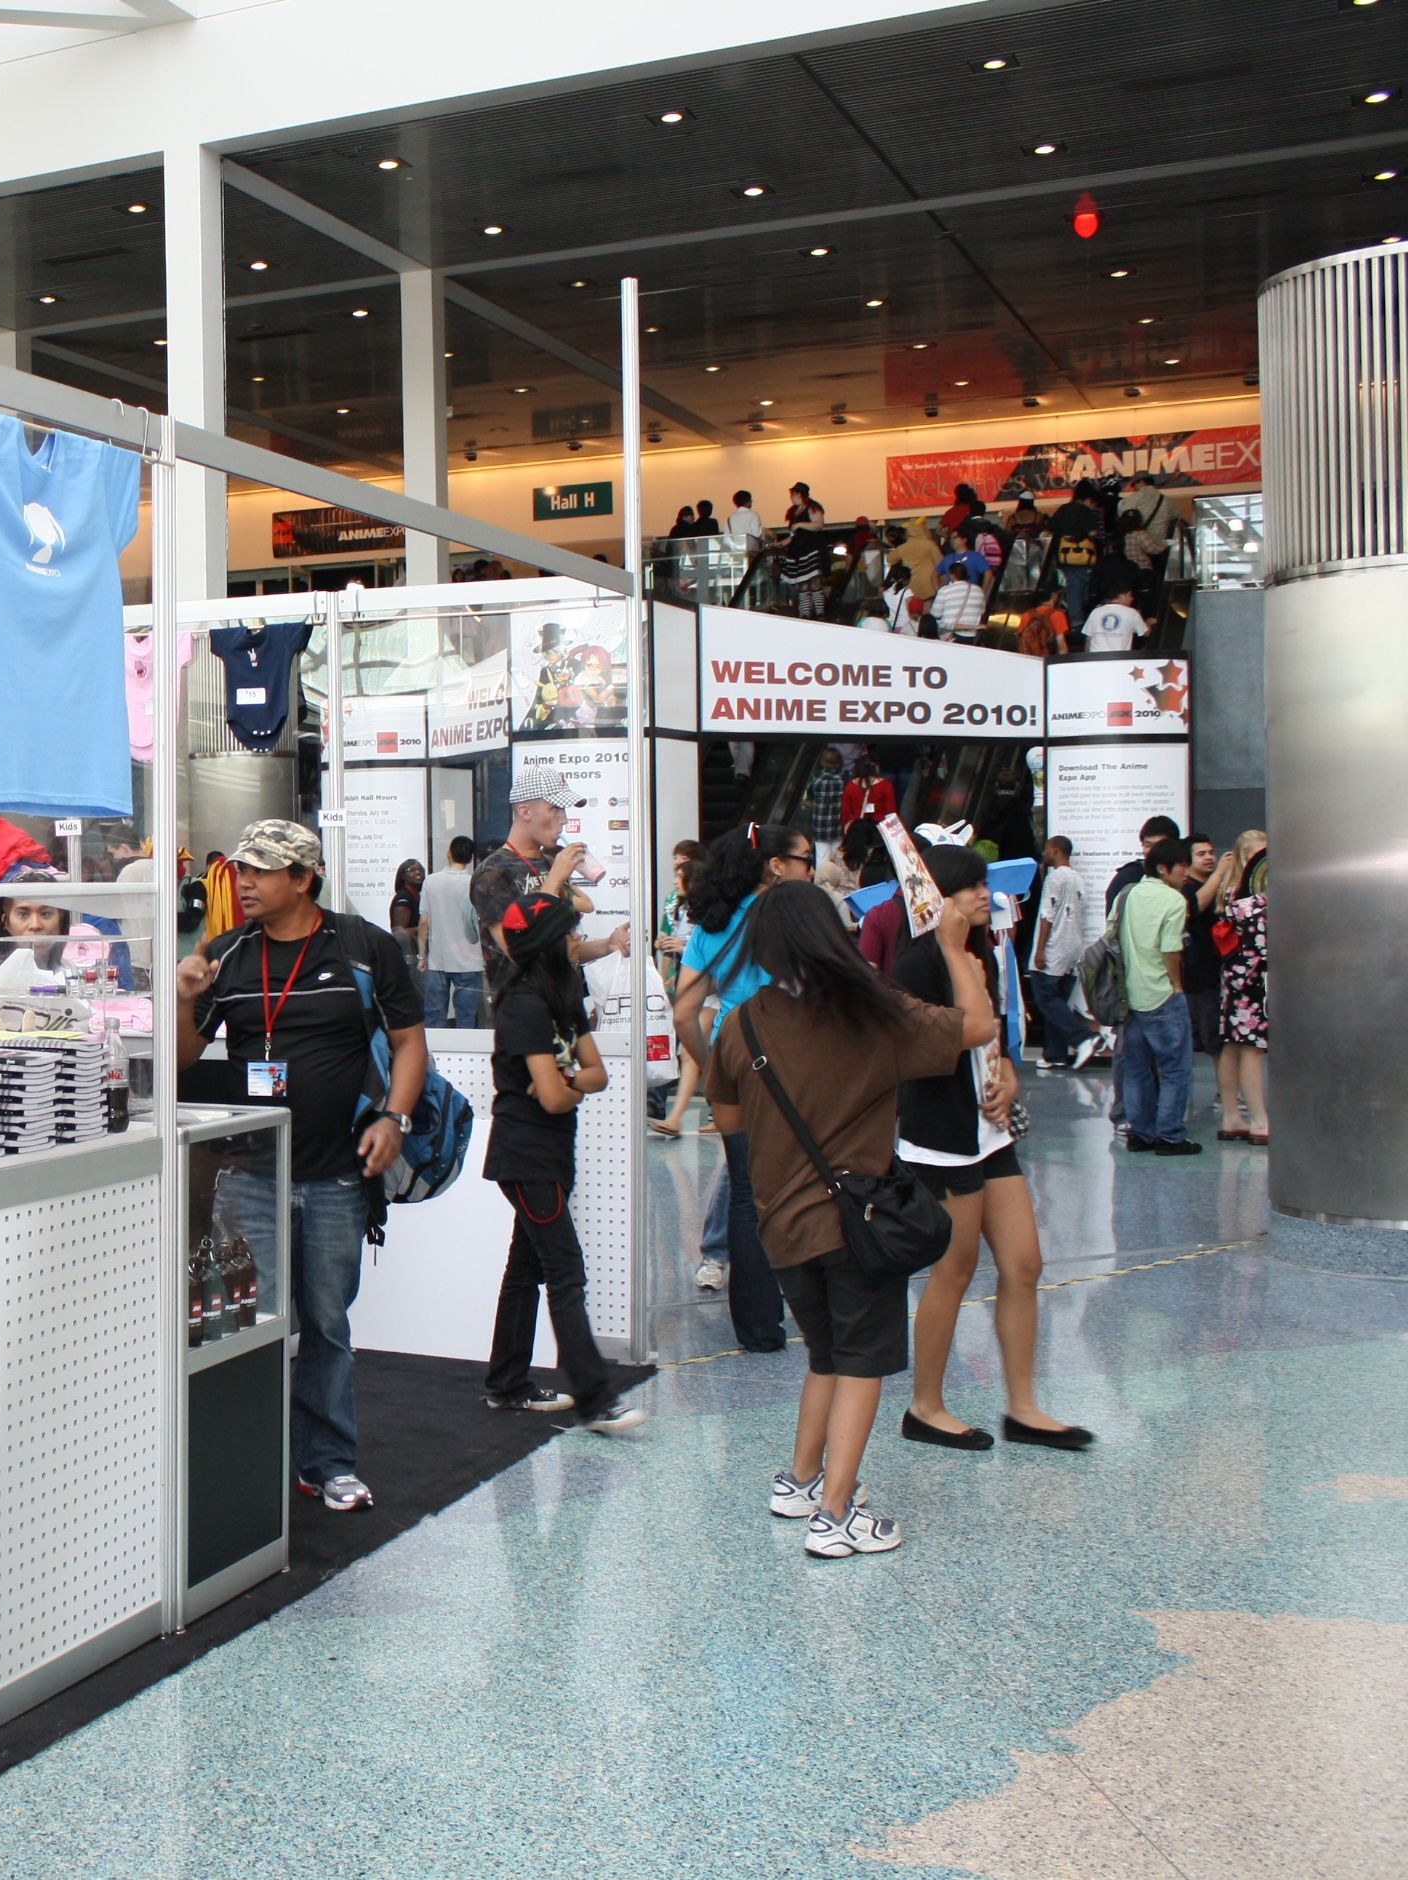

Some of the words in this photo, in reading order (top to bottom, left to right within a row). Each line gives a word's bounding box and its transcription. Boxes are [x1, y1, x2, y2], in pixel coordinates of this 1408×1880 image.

[1069, 440, 1260, 482] ANIMEEX
[550, 493, 578, 511] Hall
[584, 491, 595, 508] H
[711, 660, 892, 688] WELCOME
[902, 666, 948, 690] TO
[468, 684, 508, 711] WELC
[710, 697, 827, 721] ANIME
[838, 700, 932, 725] EXPO
[942, 703, 1037, 727] 2010!
[1134, 710, 1161, 718] 2010
[431, 722, 473, 749] ANIME
[400, 738, 422, 746] 2010
[523, 755, 555, 766] Anime
[559, 753, 590, 766] Expo
[1058, 764, 1098, 772] Download
[558, 770, 602, 779] onsors
[1058, 774, 1078, 782] Expo
[1079, 773, 1096, 782] App
[323, 812, 344, 822] Kids
[59, 822, 78, 831] Kids
